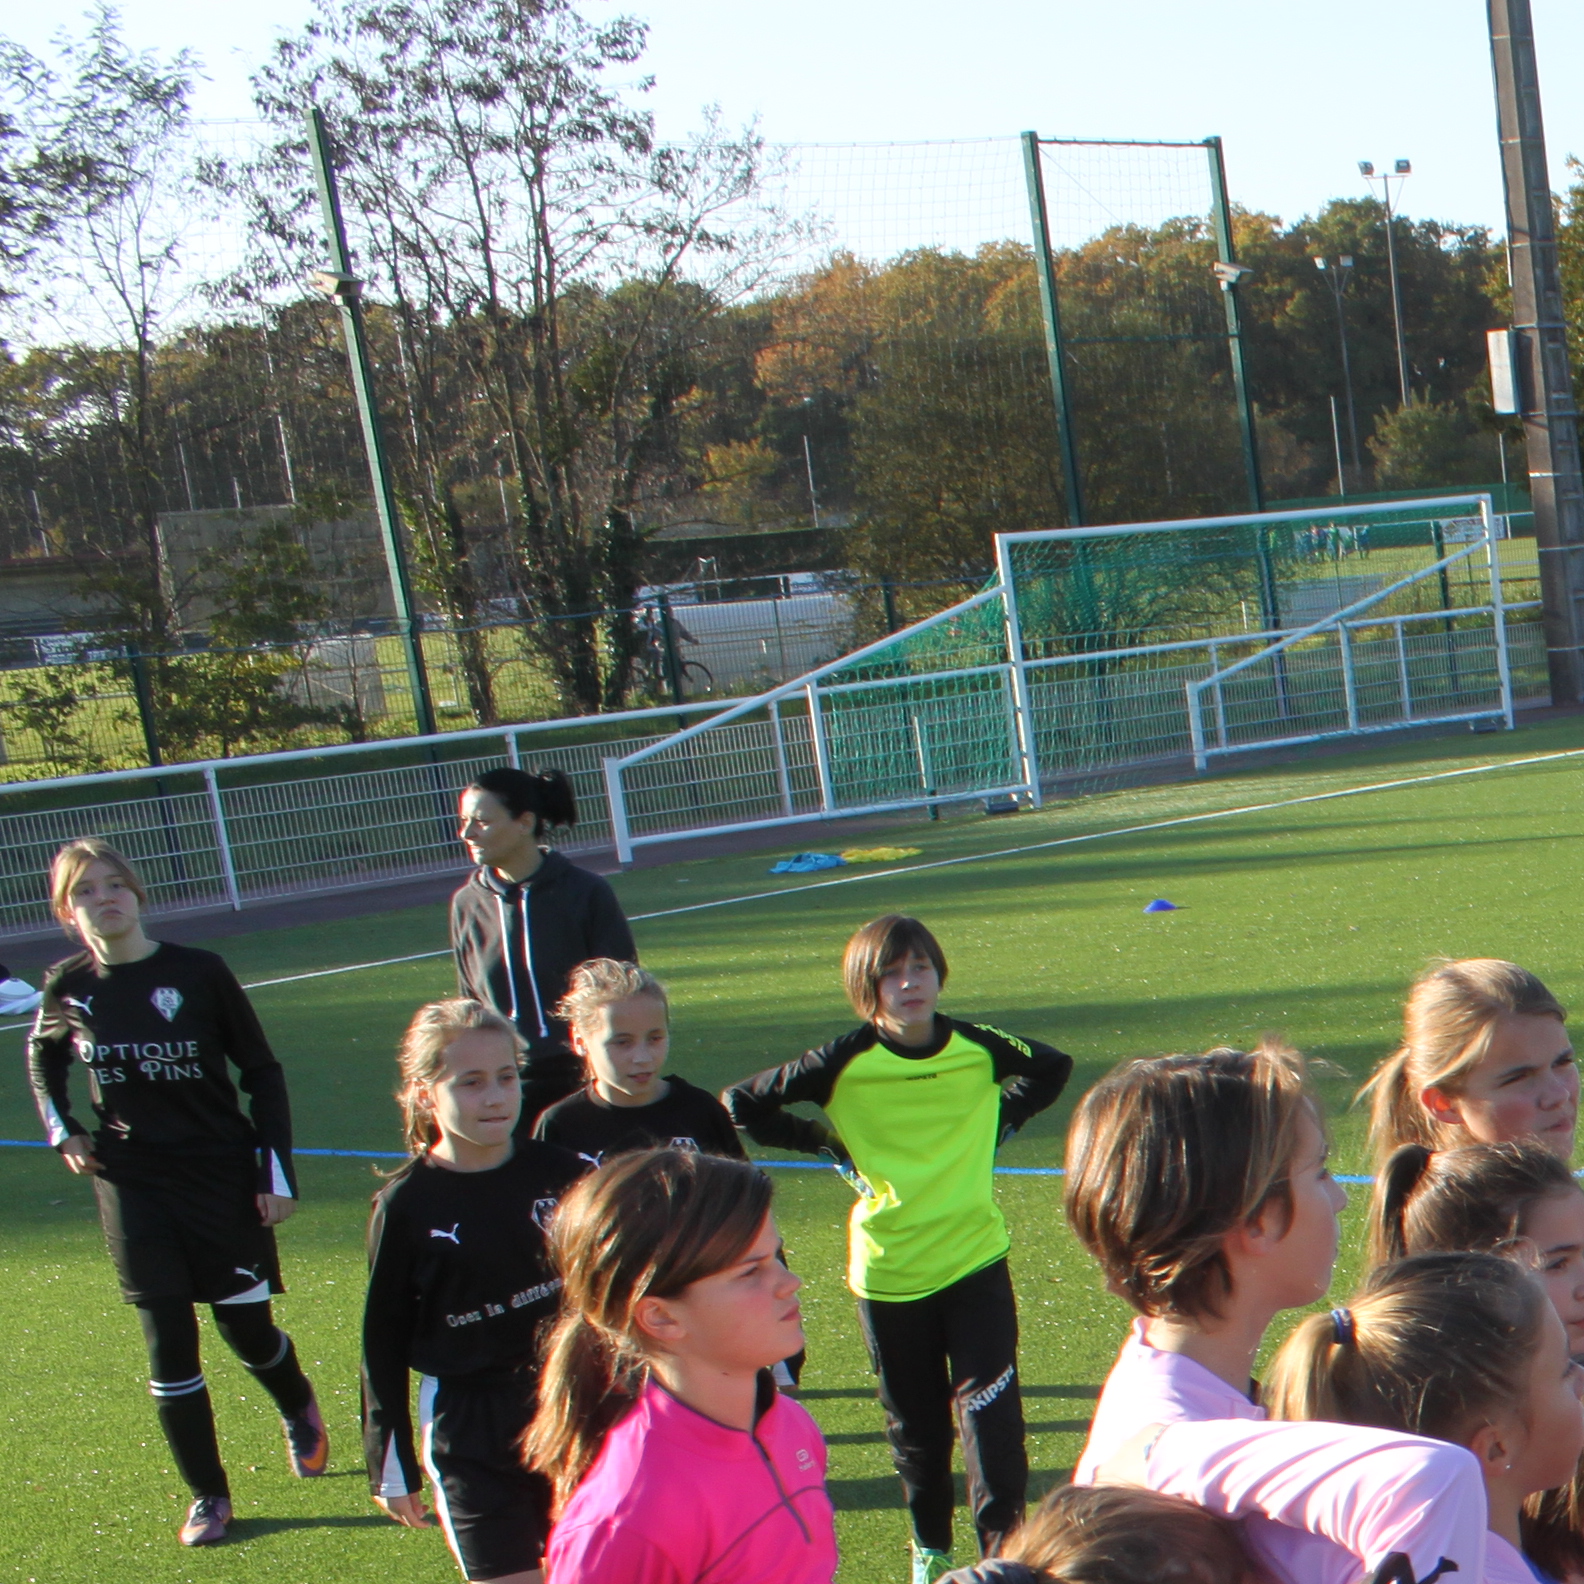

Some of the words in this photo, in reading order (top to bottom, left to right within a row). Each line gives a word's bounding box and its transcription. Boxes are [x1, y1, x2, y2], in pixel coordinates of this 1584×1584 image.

[79, 1041, 200, 1063] OPTIQUE
[95, 1066, 127, 1084] ES
[484, 1303, 505, 1317] la
